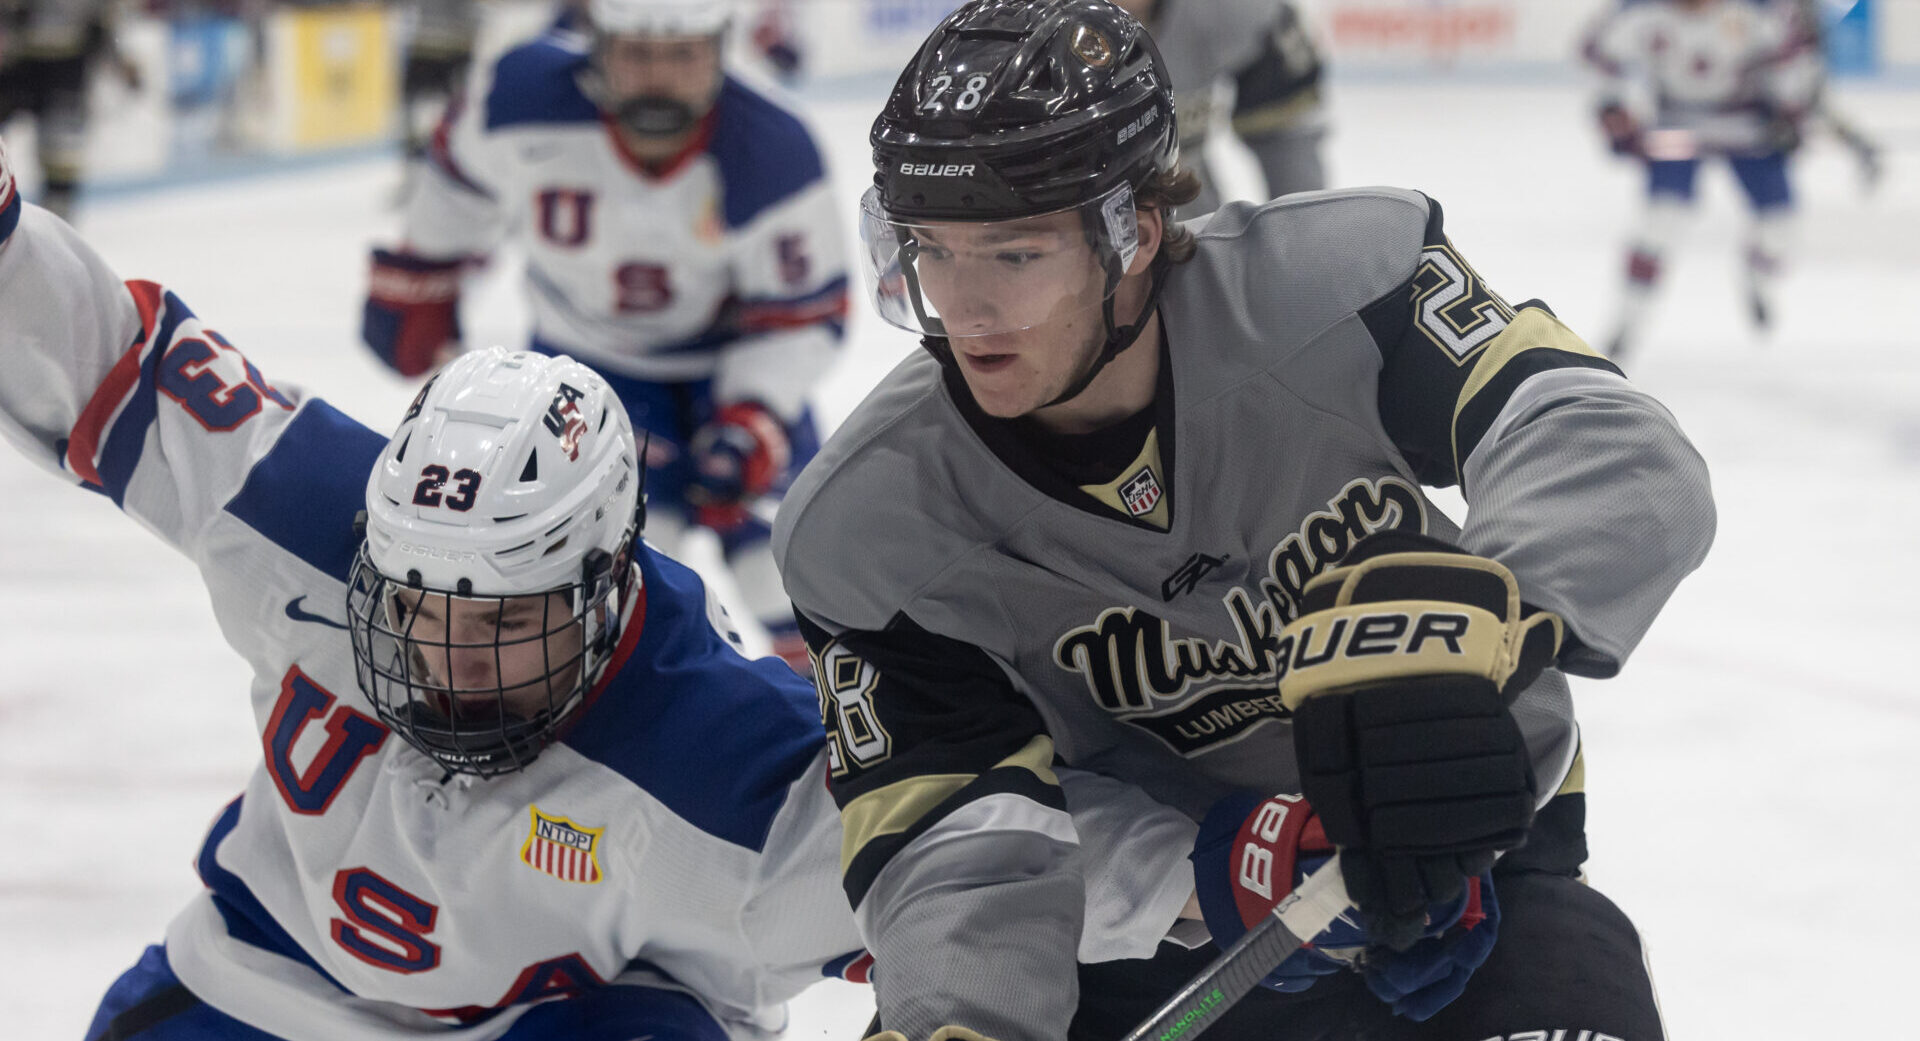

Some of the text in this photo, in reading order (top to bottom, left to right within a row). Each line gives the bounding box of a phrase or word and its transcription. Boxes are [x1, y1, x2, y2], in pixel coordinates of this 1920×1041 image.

[922, 75, 988, 111] 28
[900, 163, 976, 177] BAUER
[1409, 231, 1517, 367] 2
[412, 464, 482, 512] 23
[1127, 480, 1156, 505] USHL
[1053, 475, 1428, 712] Muskegon
[1276, 611, 1470, 680] AUER
[540, 821, 589, 849] NTDP
